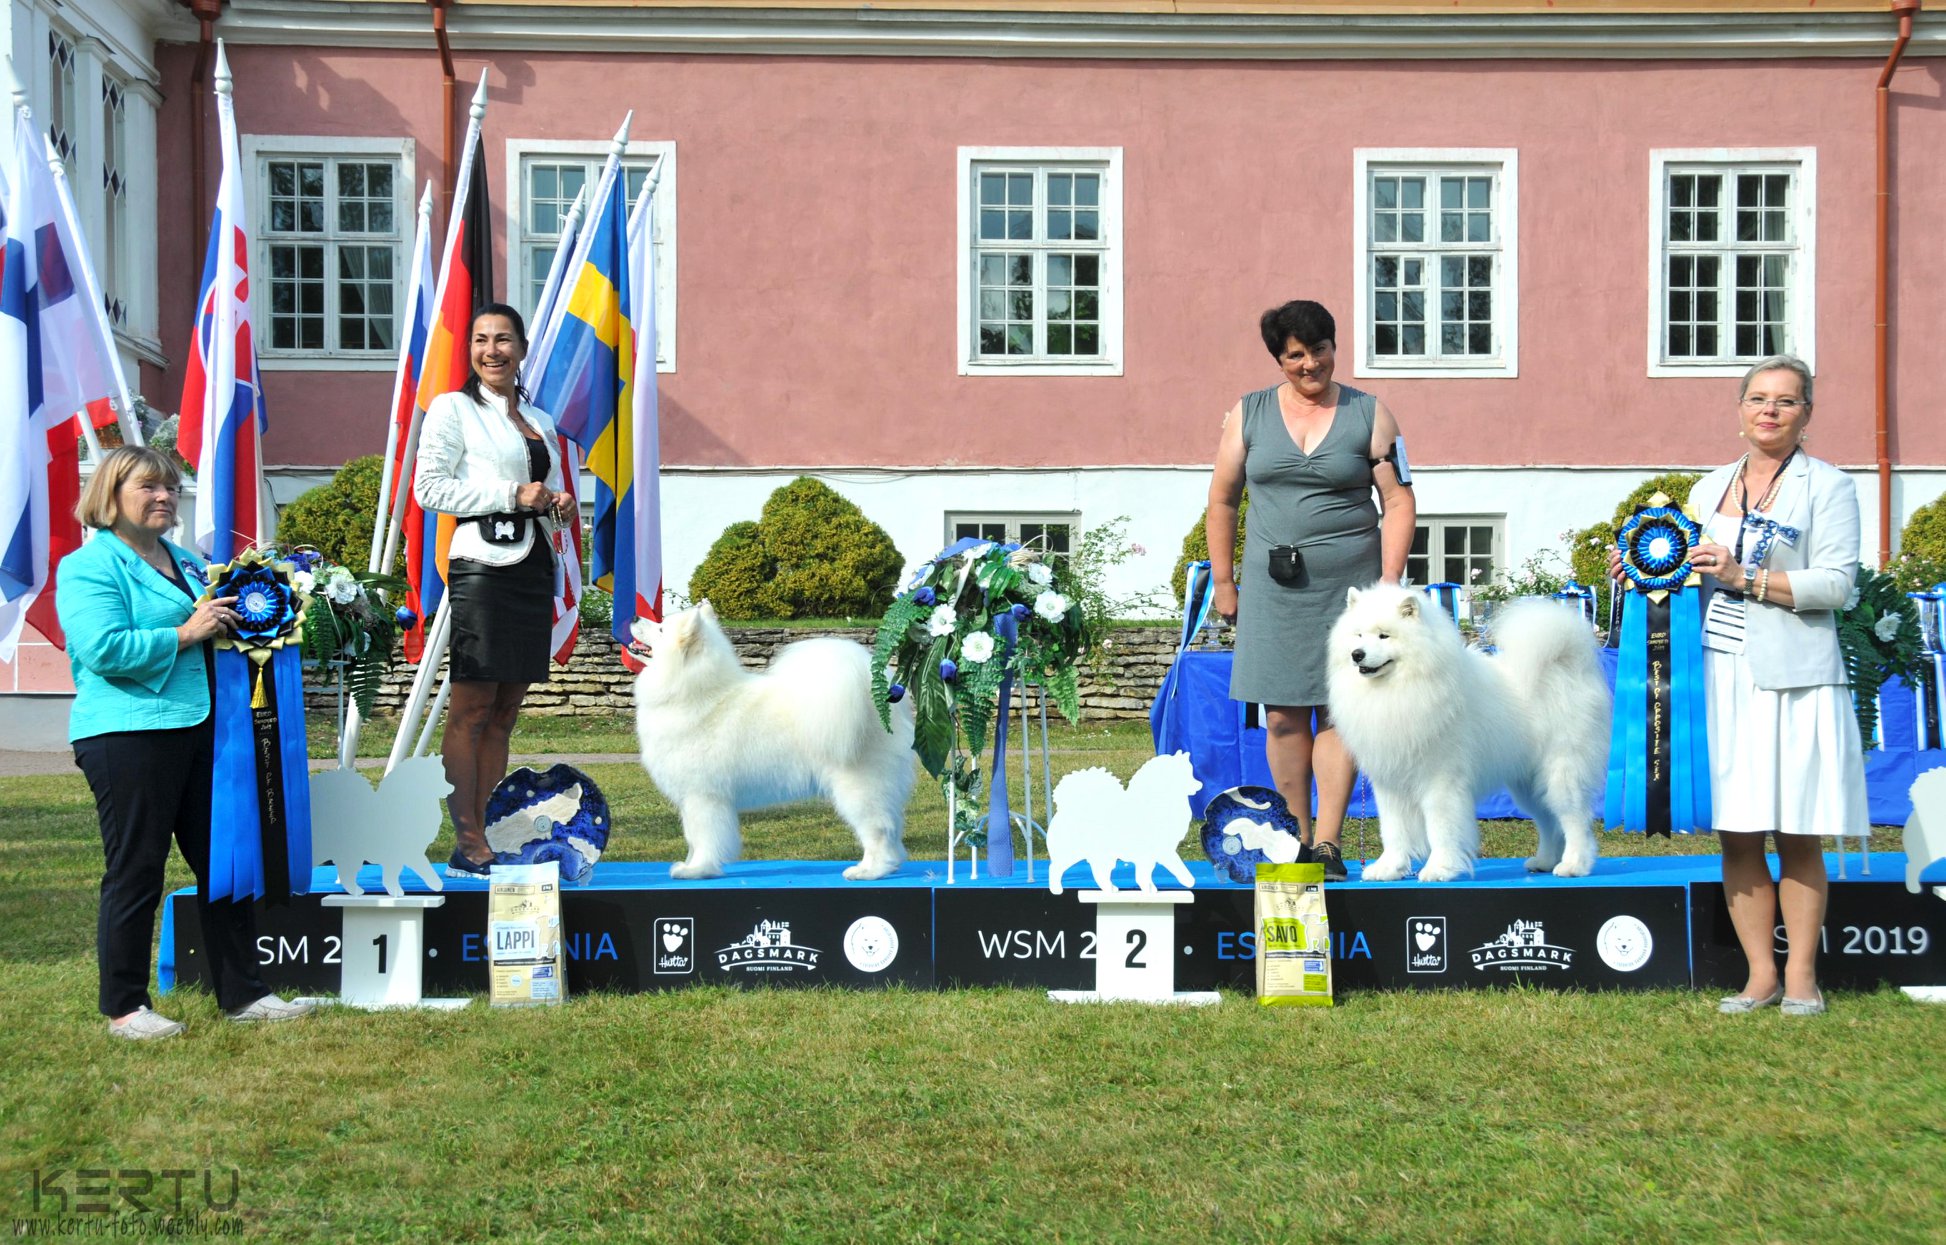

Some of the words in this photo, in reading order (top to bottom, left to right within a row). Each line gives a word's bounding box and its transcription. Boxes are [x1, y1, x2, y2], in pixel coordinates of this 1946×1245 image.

[496, 930, 535, 951] LAPPI
[978, 930, 1065, 959] WSM
[1216, 931, 1373, 961] ESIA
[1124, 928, 1147, 969] 2
[1267, 925, 1298, 944] SAVO
[1842, 925, 1929, 955] 2019
[256, 935, 308, 965] SM
[372, 933, 388, 974] 1
[718, 948, 819, 964] DAGSMARK
[1471, 949, 1573, 964] DAGSMARK
